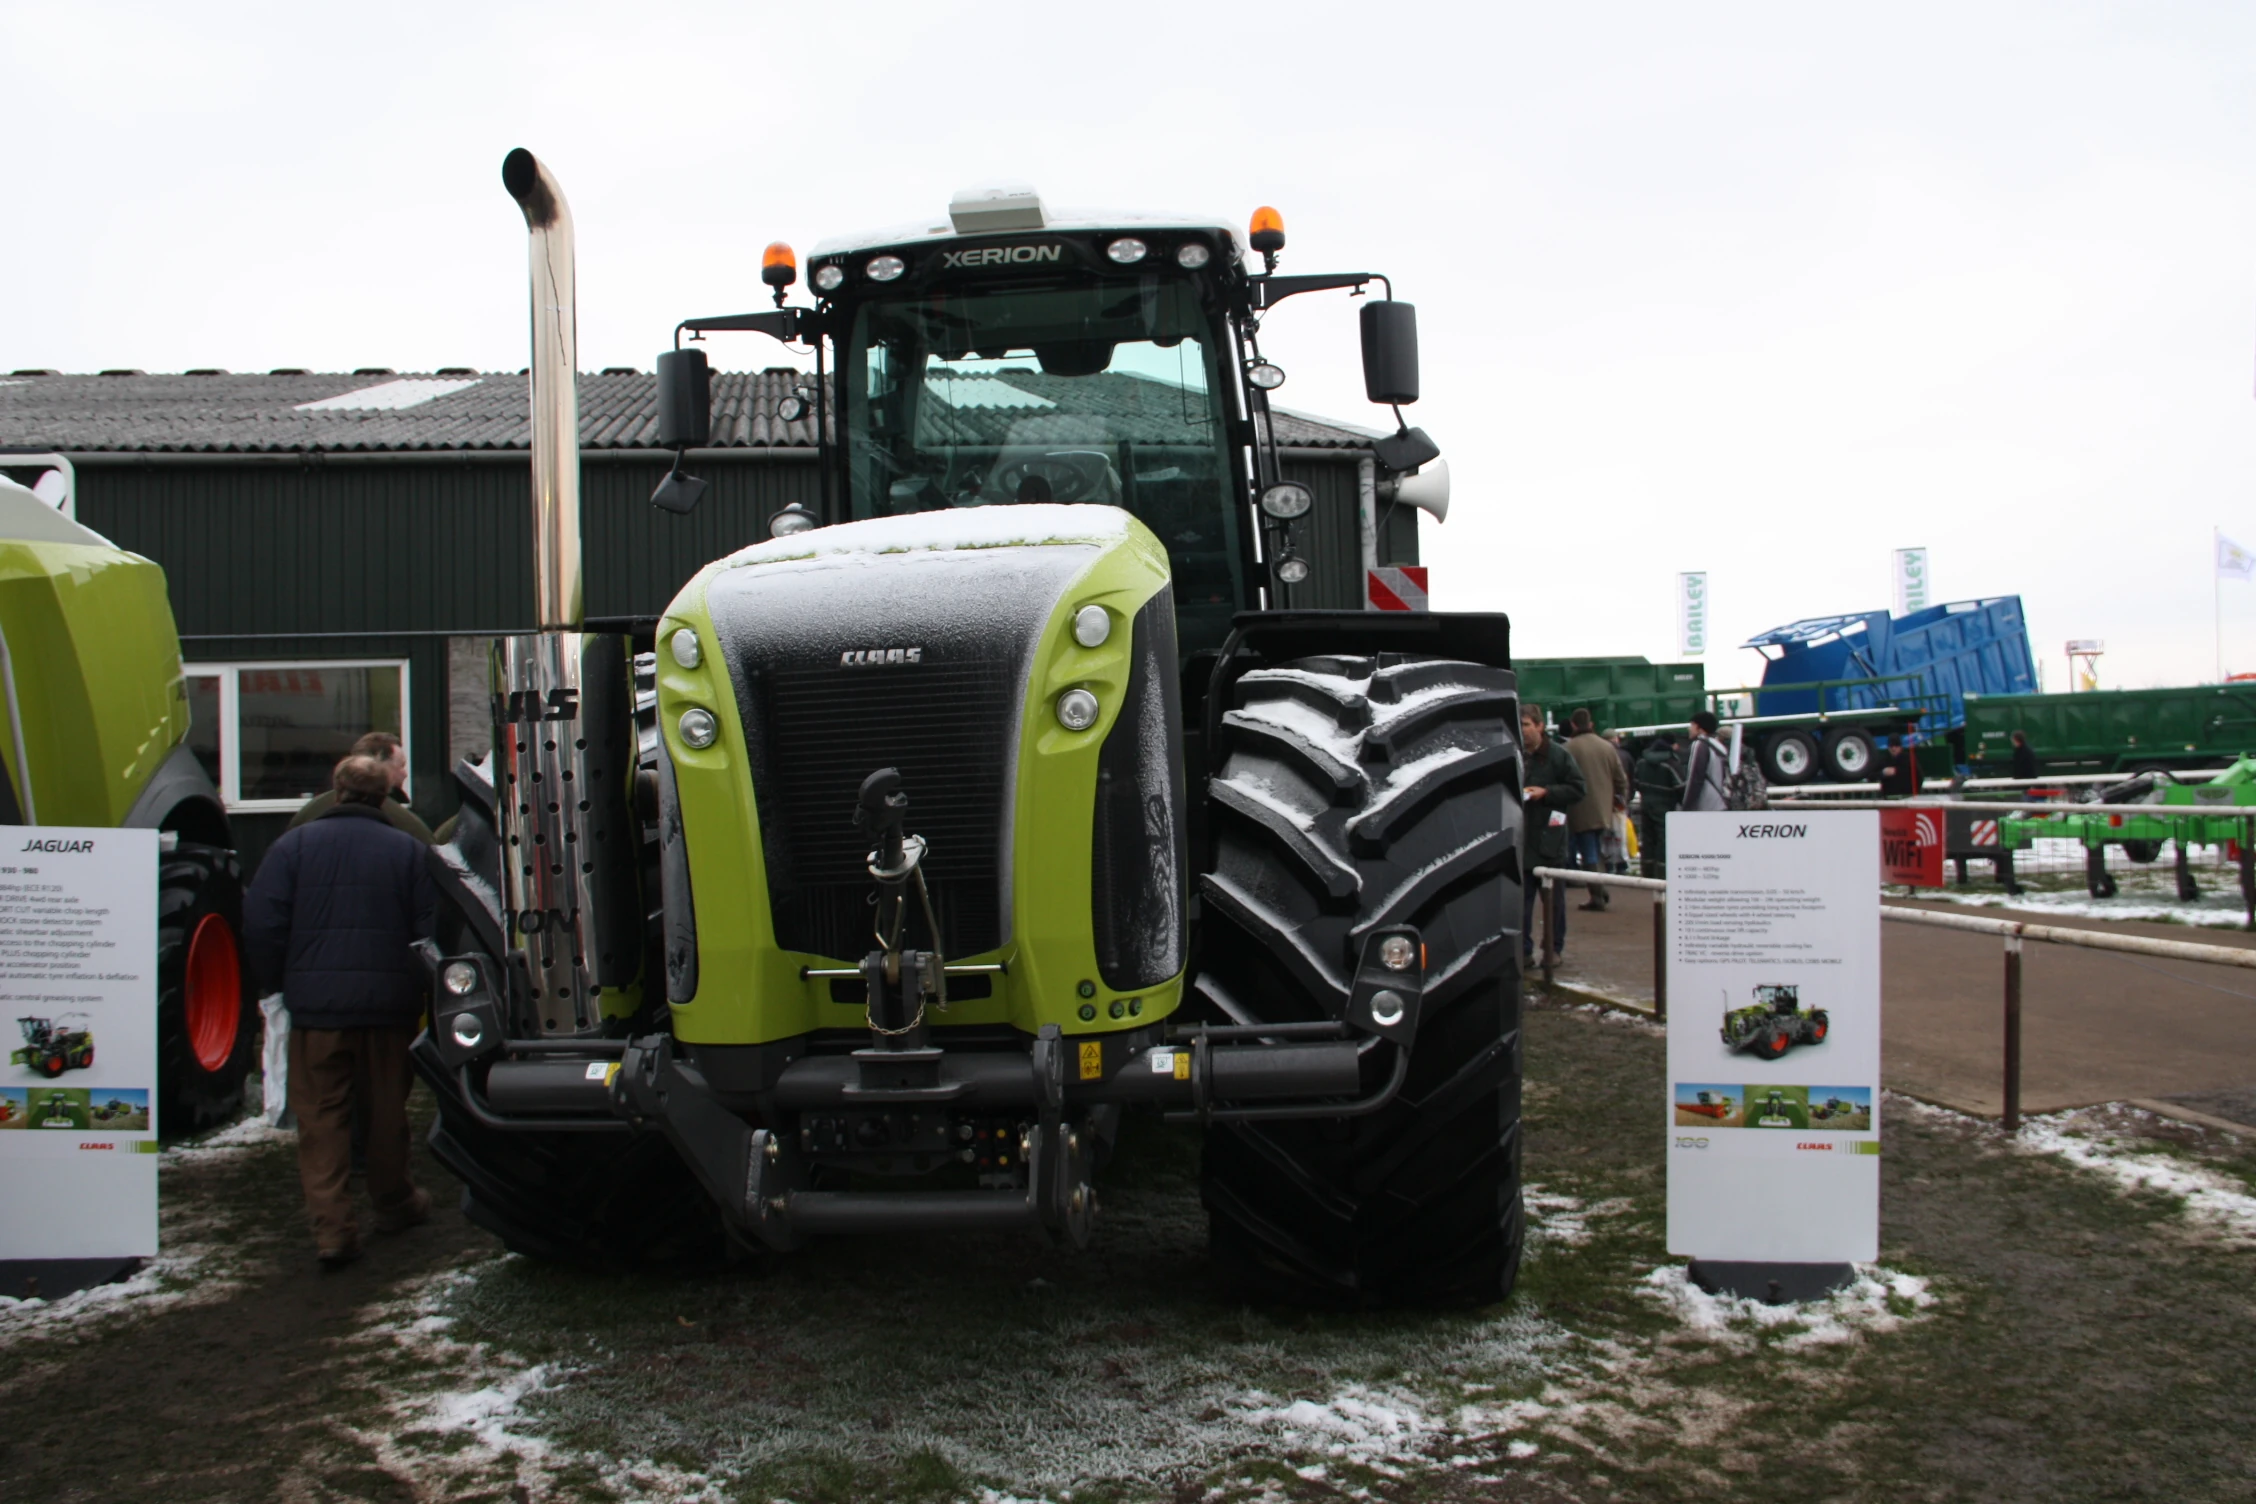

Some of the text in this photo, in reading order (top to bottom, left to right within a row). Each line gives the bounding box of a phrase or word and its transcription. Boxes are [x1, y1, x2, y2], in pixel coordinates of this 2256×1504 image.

[943, 244, 1062, 268] XERION
[1904, 552, 1925, 613] AILEY
[1687, 576, 1703, 647] BAILEY
[841, 647, 922, 666] CLAAS
[1736, 824, 1807, 838] XERION
[21, 839, 94, 853] JAGUAR
[1882, 839, 1922, 868] WiFi
[79, 1142, 115, 1150] CLAAS
[1796, 1142, 1833, 1150] CLAAS
